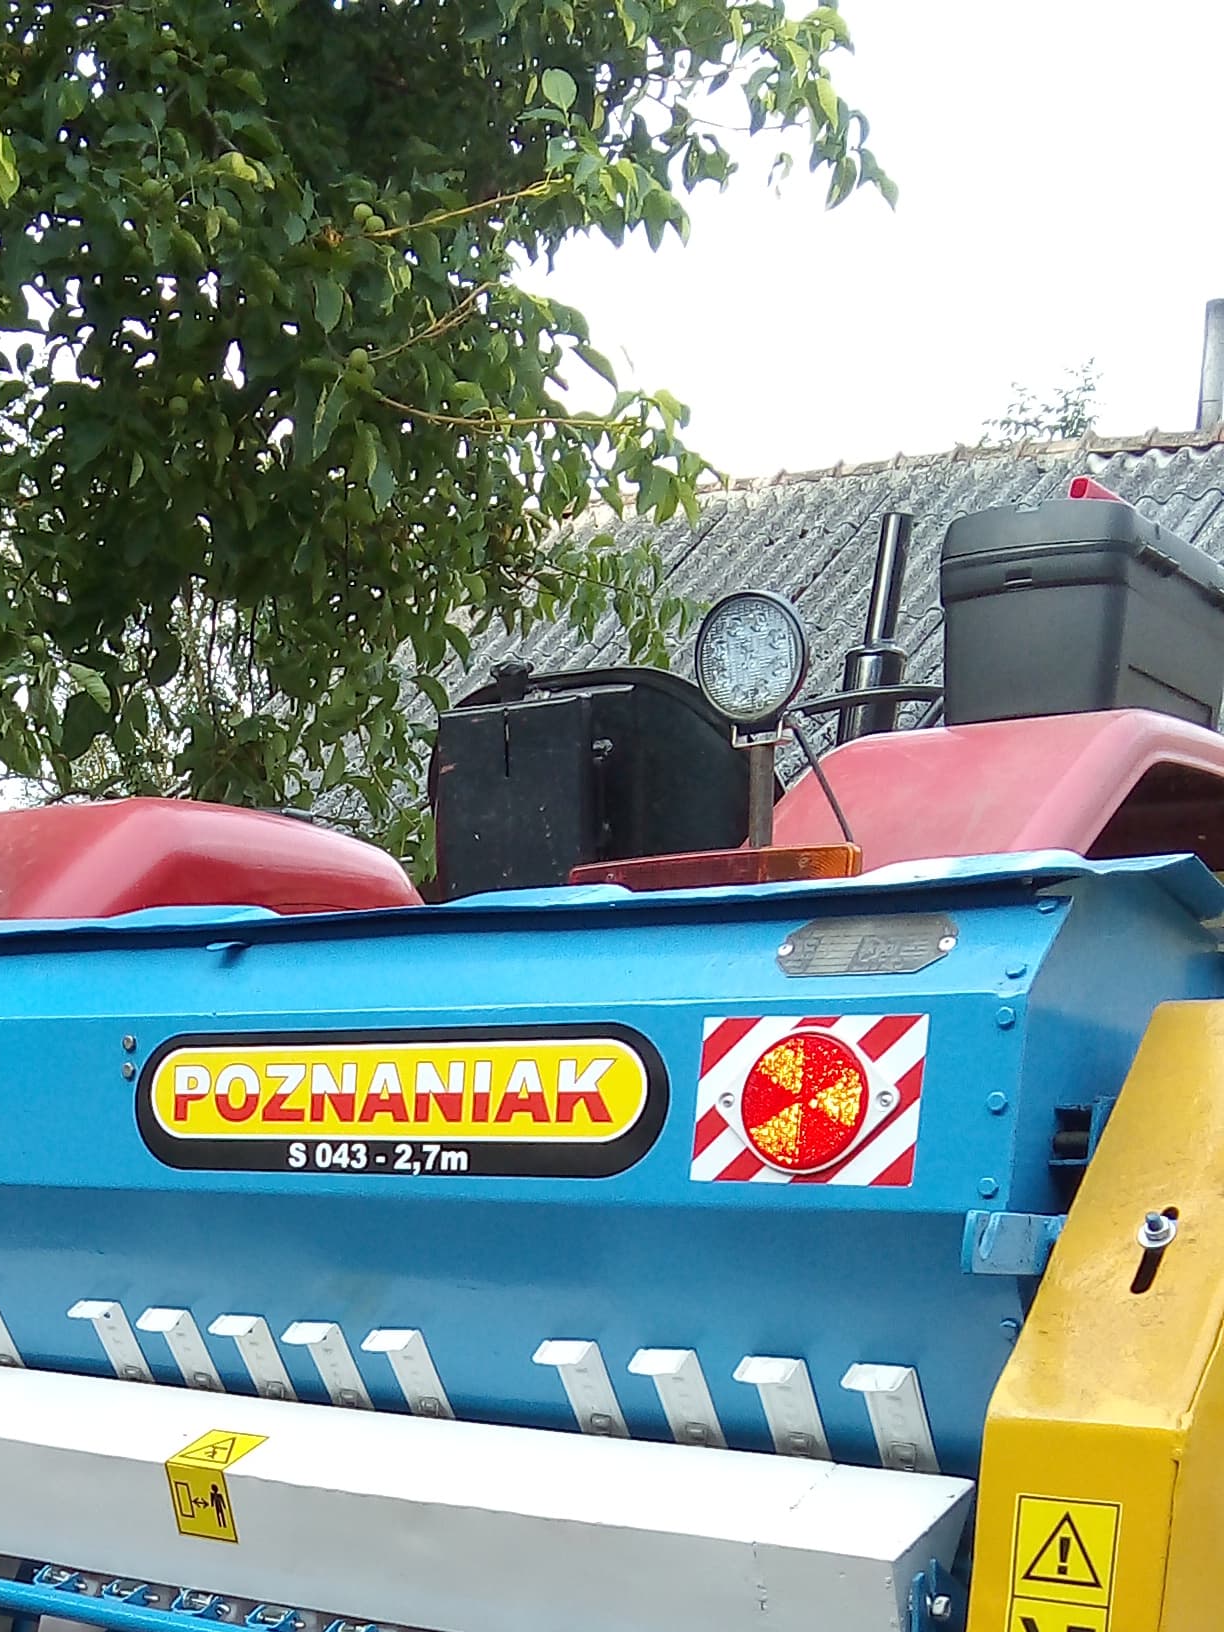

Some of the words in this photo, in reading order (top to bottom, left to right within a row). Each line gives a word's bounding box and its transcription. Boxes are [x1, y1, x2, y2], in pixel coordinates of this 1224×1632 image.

[173, 1058, 618, 1123] POZNANIAK
[288, 1143, 308, 1169] S
[315, 1142, 368, 1169] 043
[392, 1144, 469, 1177] 2,7m
